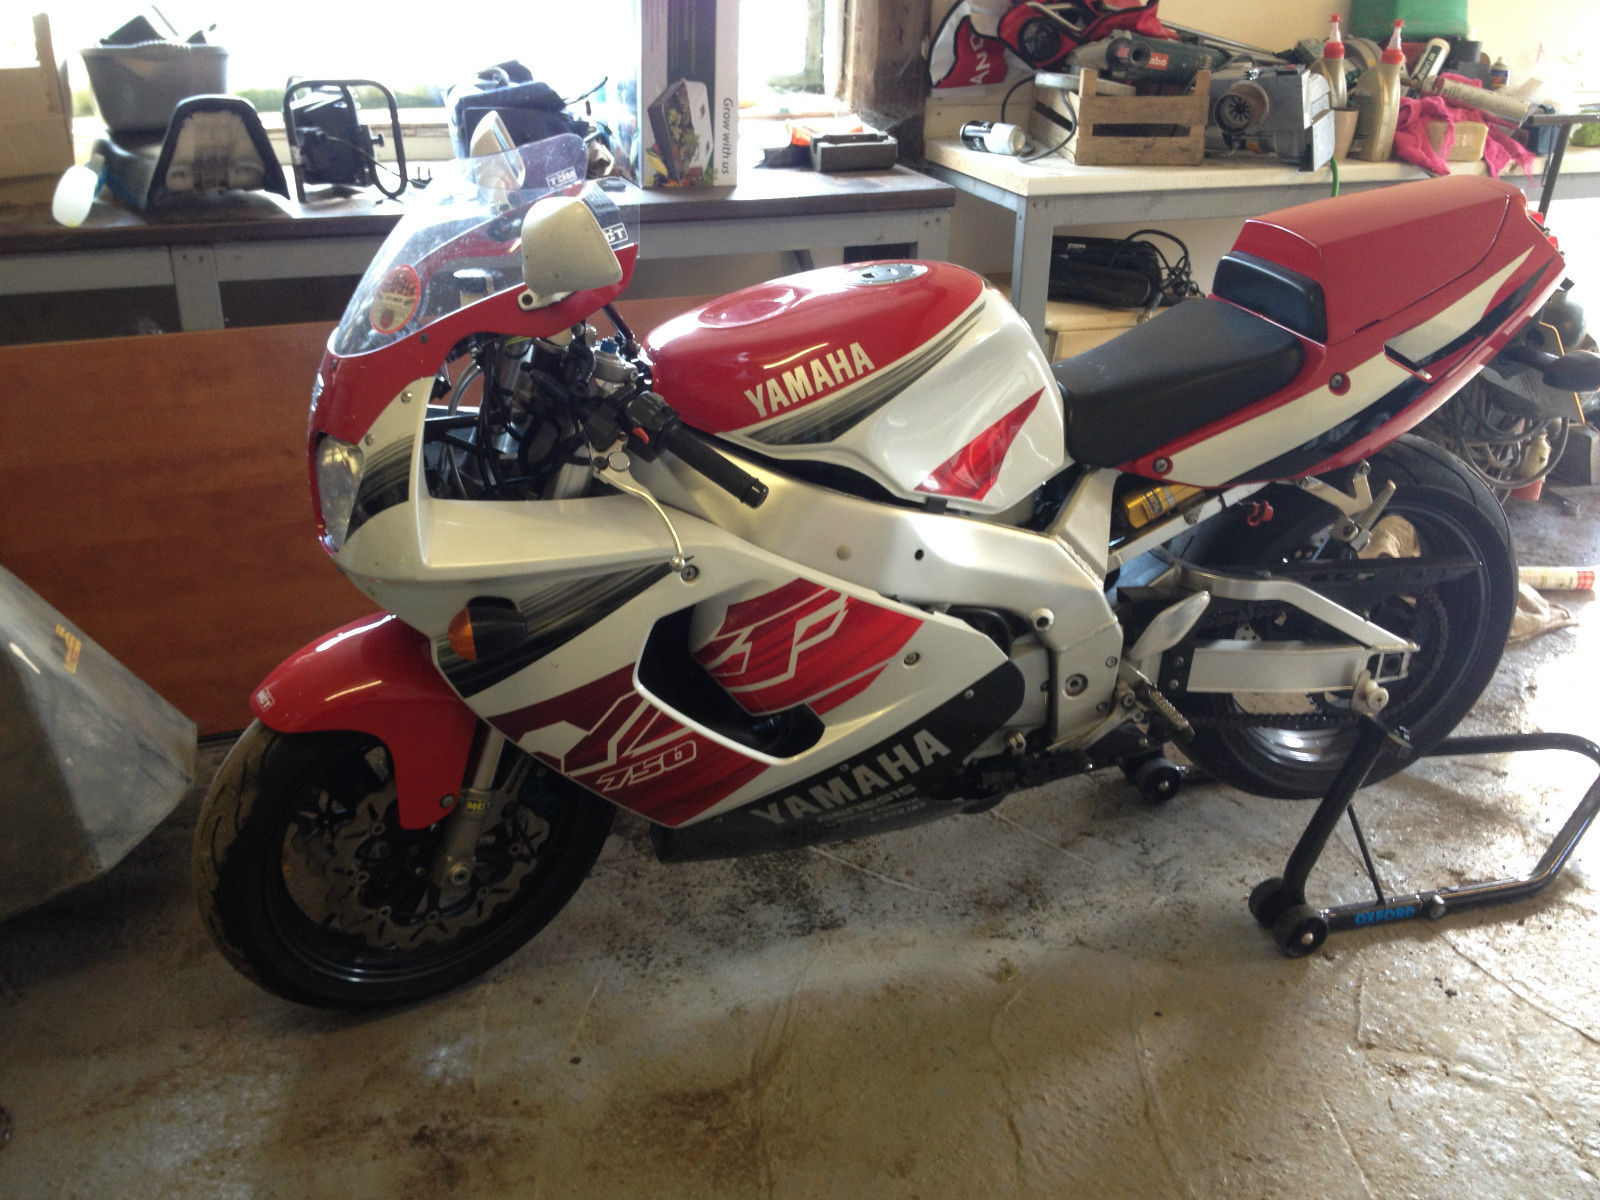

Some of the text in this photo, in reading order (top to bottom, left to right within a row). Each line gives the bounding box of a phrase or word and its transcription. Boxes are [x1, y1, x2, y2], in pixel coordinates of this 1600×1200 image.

[721, 97, 734, 175] Grow with us
[743, 342, 875, 418] YAMAHA
[595, 740, 697, 793] 750
[750, 728, 951, 825] YAMAHA
